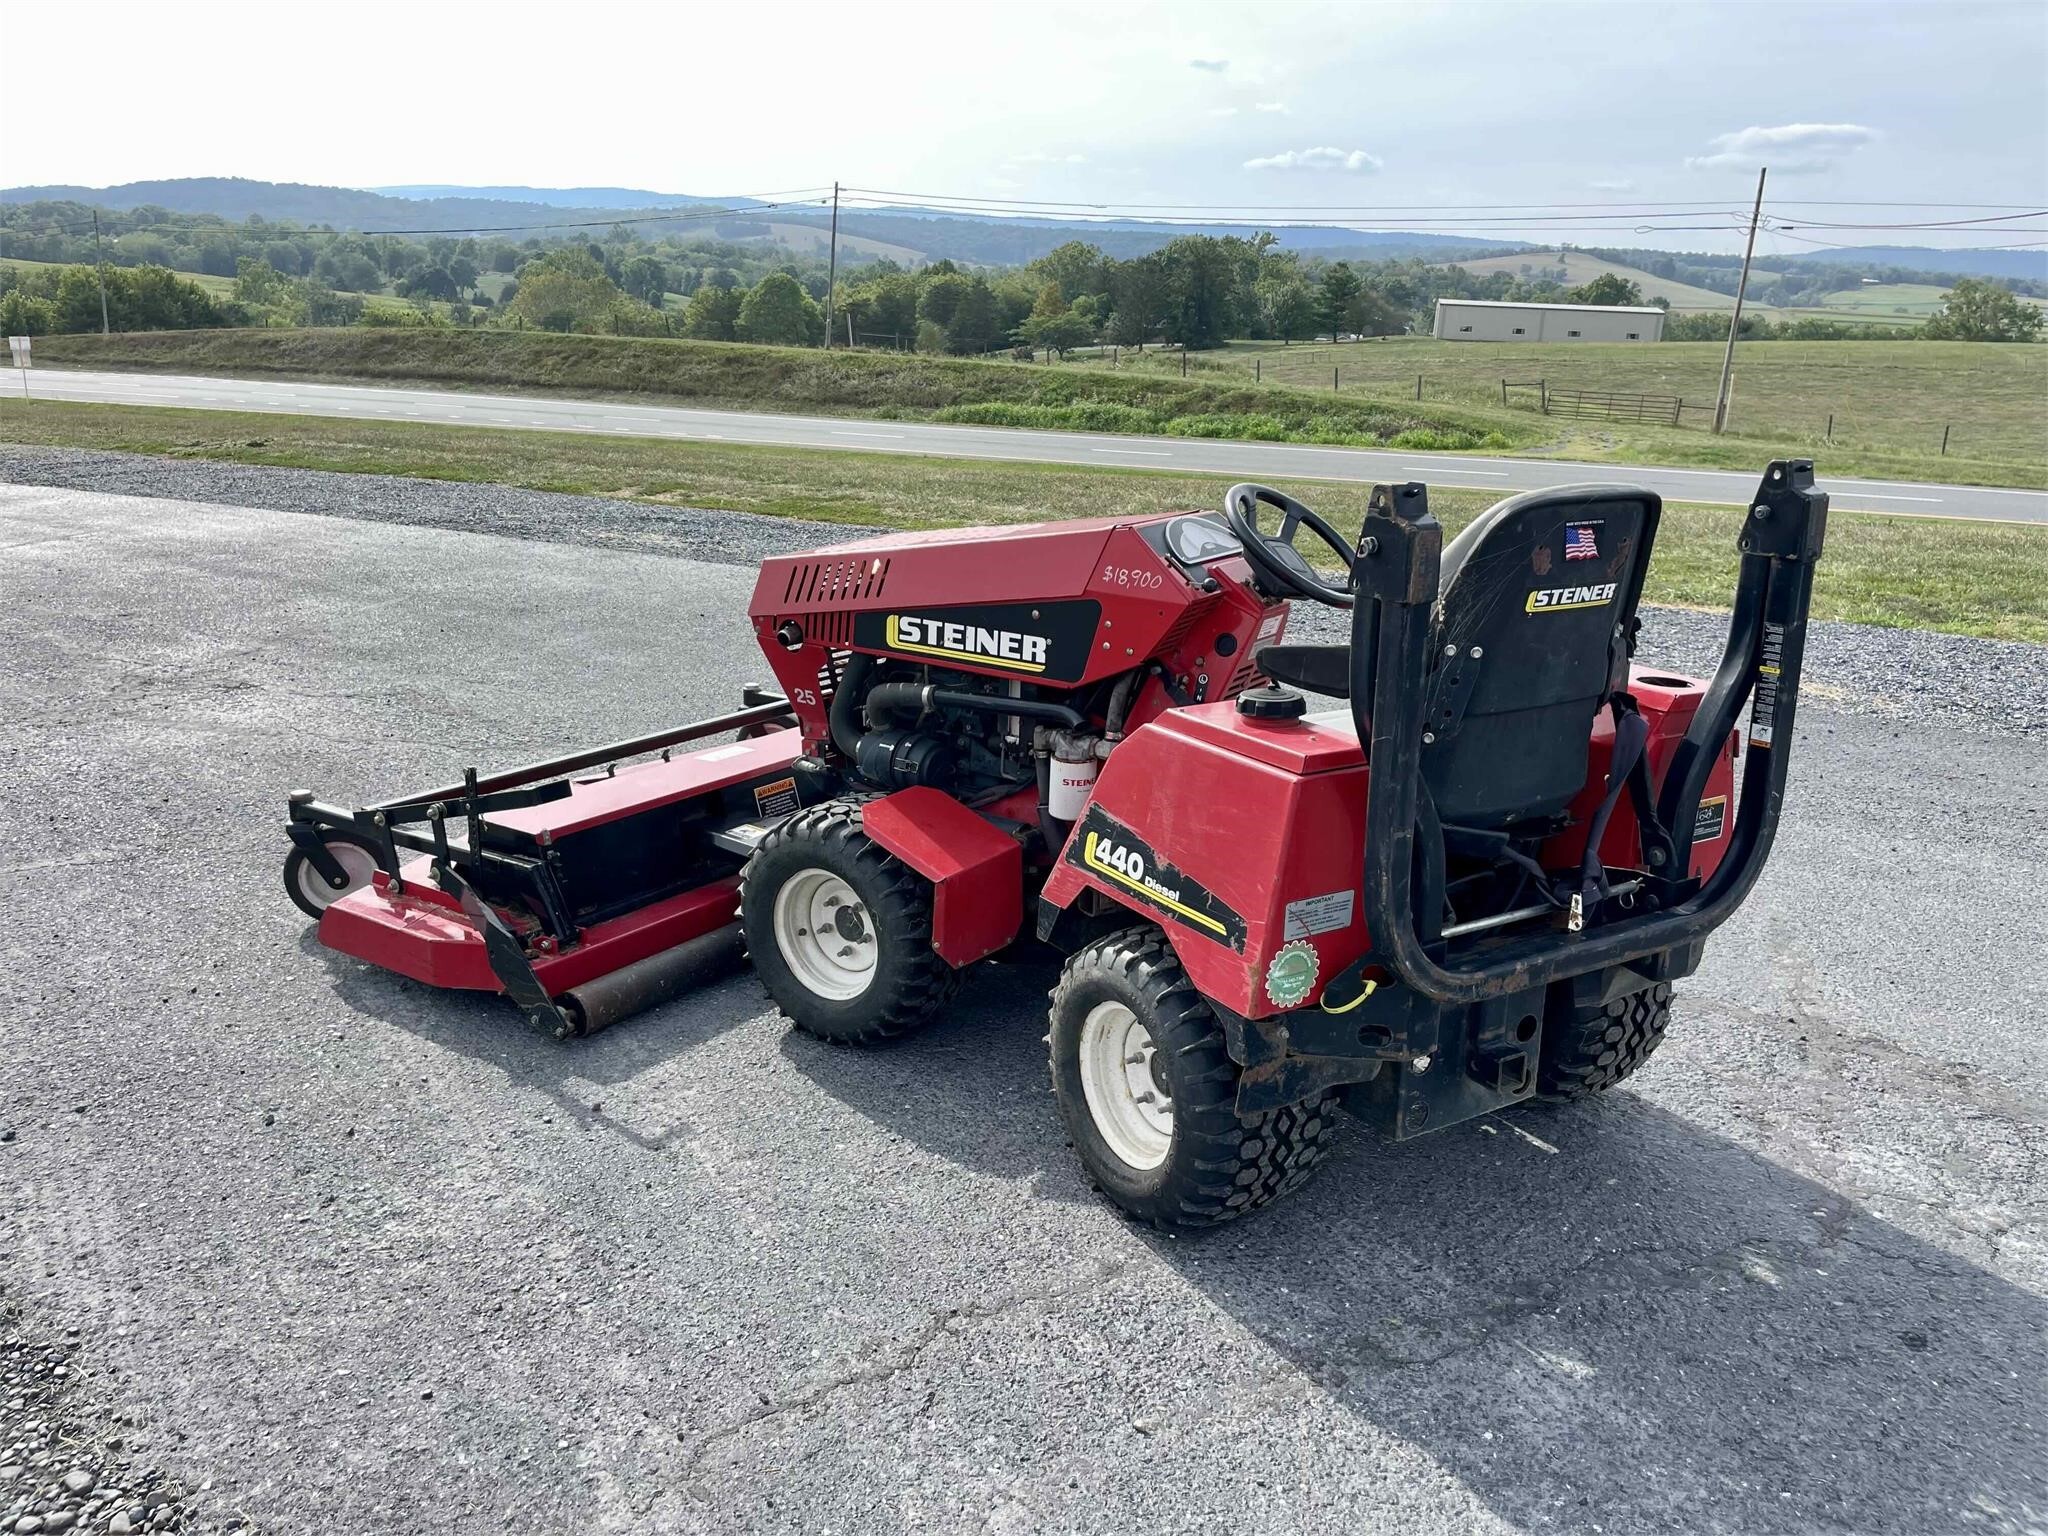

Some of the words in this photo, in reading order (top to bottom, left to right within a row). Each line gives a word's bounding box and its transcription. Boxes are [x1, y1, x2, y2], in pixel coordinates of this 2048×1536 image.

[1102, 565, 1163, 589] $18,900
[1534, 583, 1618, 607] STEINER
[899, 615, 1047, 664] STEINER
[794, 688, 816, 705] 25
[761, 780, 788, 795] WARNING
[1062, 778, 1096, 787] STEINE
[1096, 838, 1144, 880] 440
[1144, 875, 1180, 902] Diesel
[1305, 895, 1335, 907] IMPORTANT
